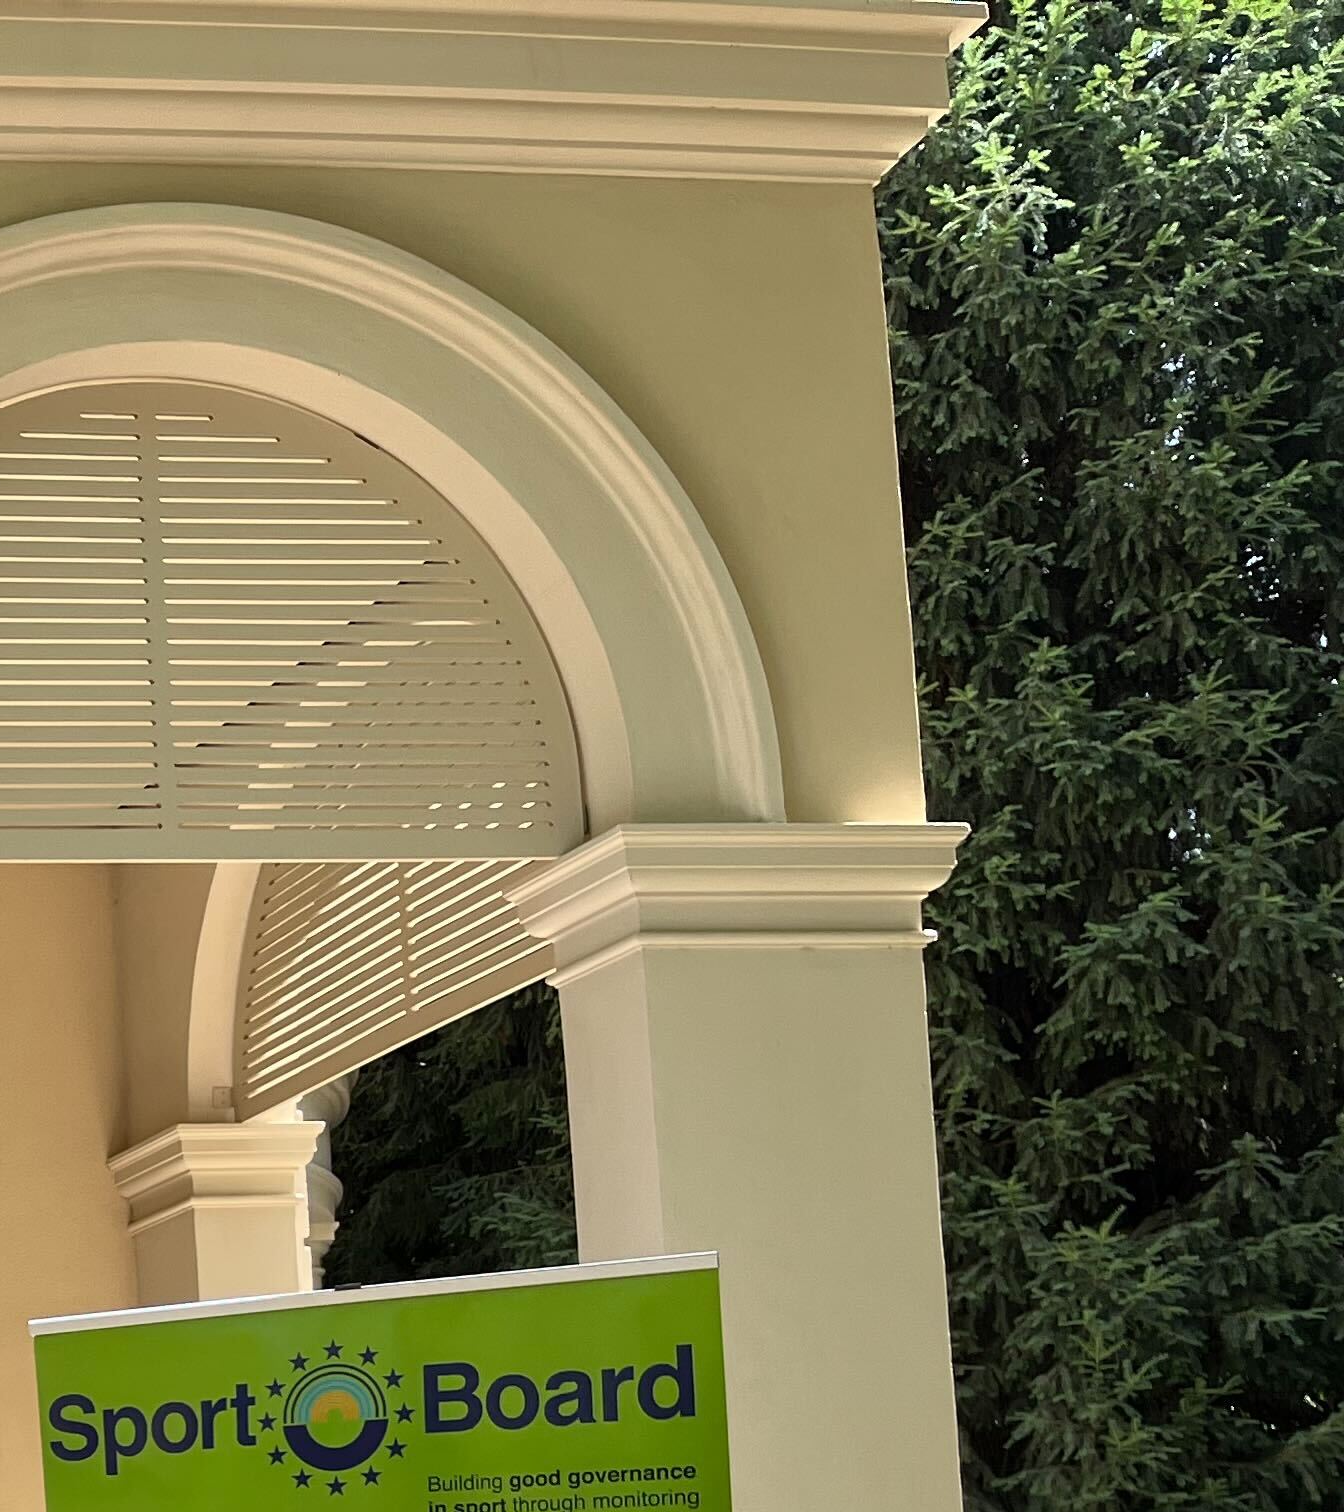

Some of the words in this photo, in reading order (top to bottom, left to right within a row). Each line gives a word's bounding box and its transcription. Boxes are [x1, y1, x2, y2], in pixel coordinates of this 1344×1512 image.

[49, 1384, 257, 1476] Sport
[423, 1344, 696, 1433] Board
[428, 1474, 503, 1493] Building
[510, 1470, 561, 1490] good
[568, 1466, 697, 1488] governance
[593, 1491, 700, 1510] monitoring
